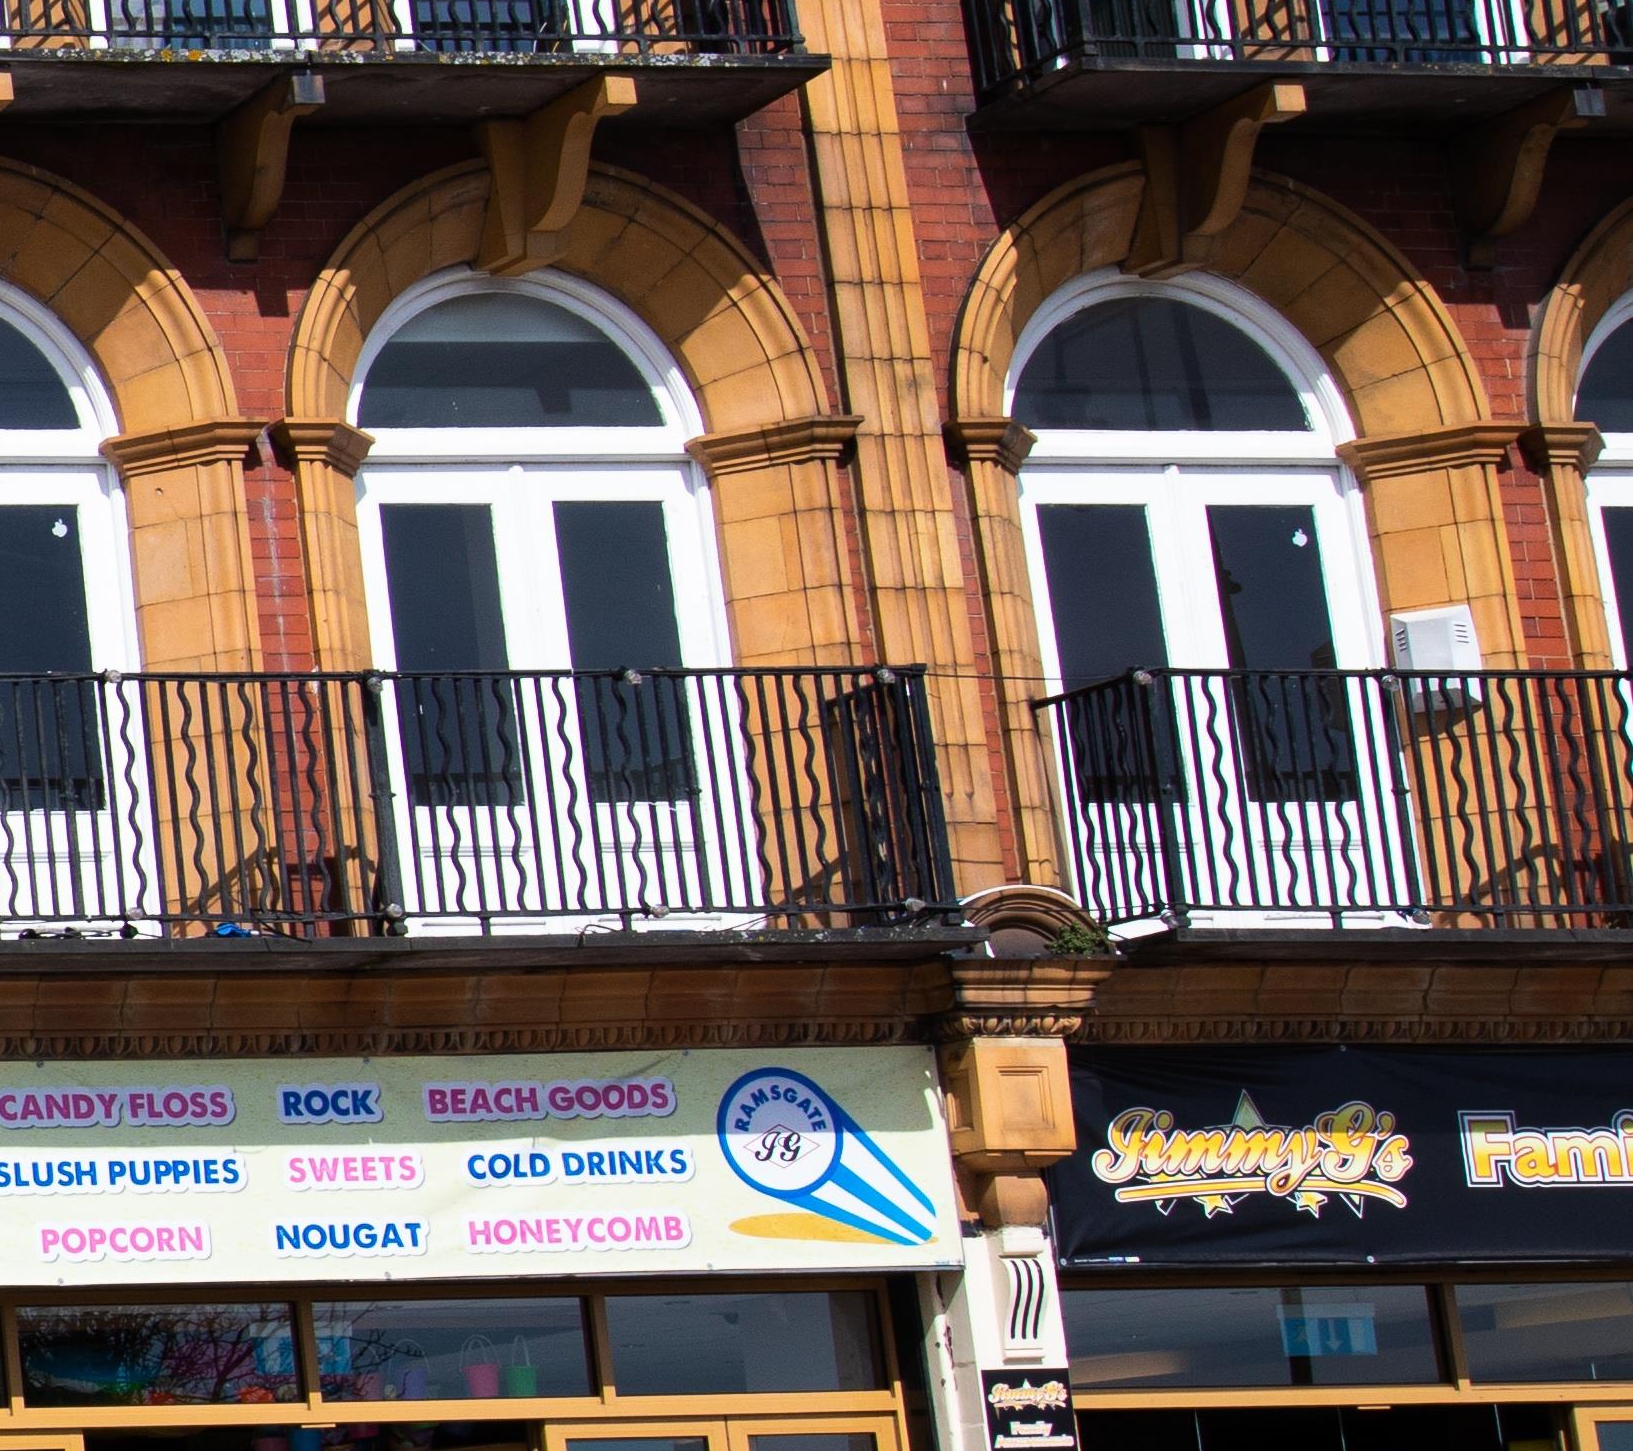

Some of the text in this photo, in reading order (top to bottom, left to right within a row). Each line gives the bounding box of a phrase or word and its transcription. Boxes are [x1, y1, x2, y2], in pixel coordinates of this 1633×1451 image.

[127, 1089, 229, 1120] FLOSS
[280, 1088, 377, 1122] ROCK
[428, 1081, 670, 1118] BEACH GOODS
[734, 1084, 827, 1132] RAMSGATE
[108, 1158, 241, 1187] PUPPIES
[289, 1155, 418, 1184] SWEETS
[468, 1148, 689, 1182] COLD DRINKS
[41, 1226, 205, 1255] POPCORN
[276, 1222, 423, 1252] NOUGAT
[468, 1215, 685, 1247] HONEYCOMB
